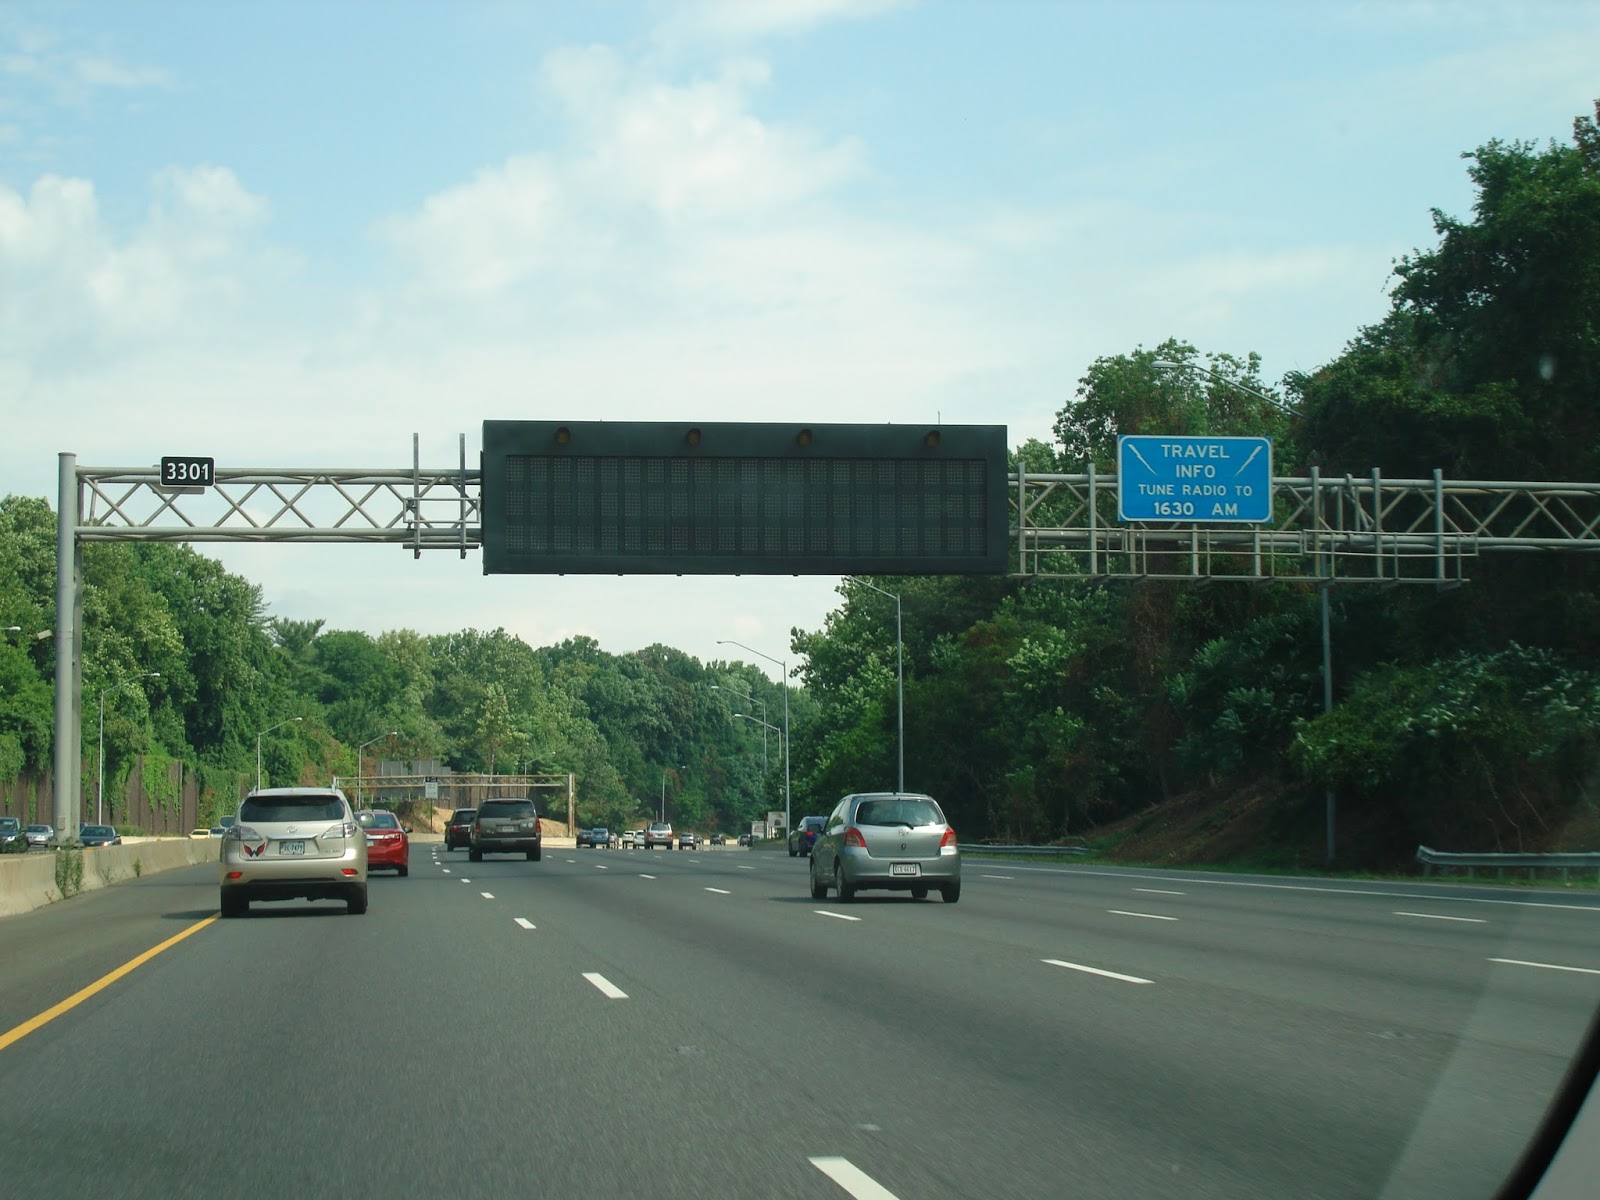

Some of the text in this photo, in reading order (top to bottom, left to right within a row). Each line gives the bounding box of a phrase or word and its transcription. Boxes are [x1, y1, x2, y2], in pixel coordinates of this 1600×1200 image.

[1161, 444, 1230, 459] TRAVEL
[167, 462, 208, 480] 3301
[1176, 464, 1216, 478] INFO
[1138, 484, 1253, 497] TUNE RADIO TO
[1154, 502, 1238, 516] 1630 AM
